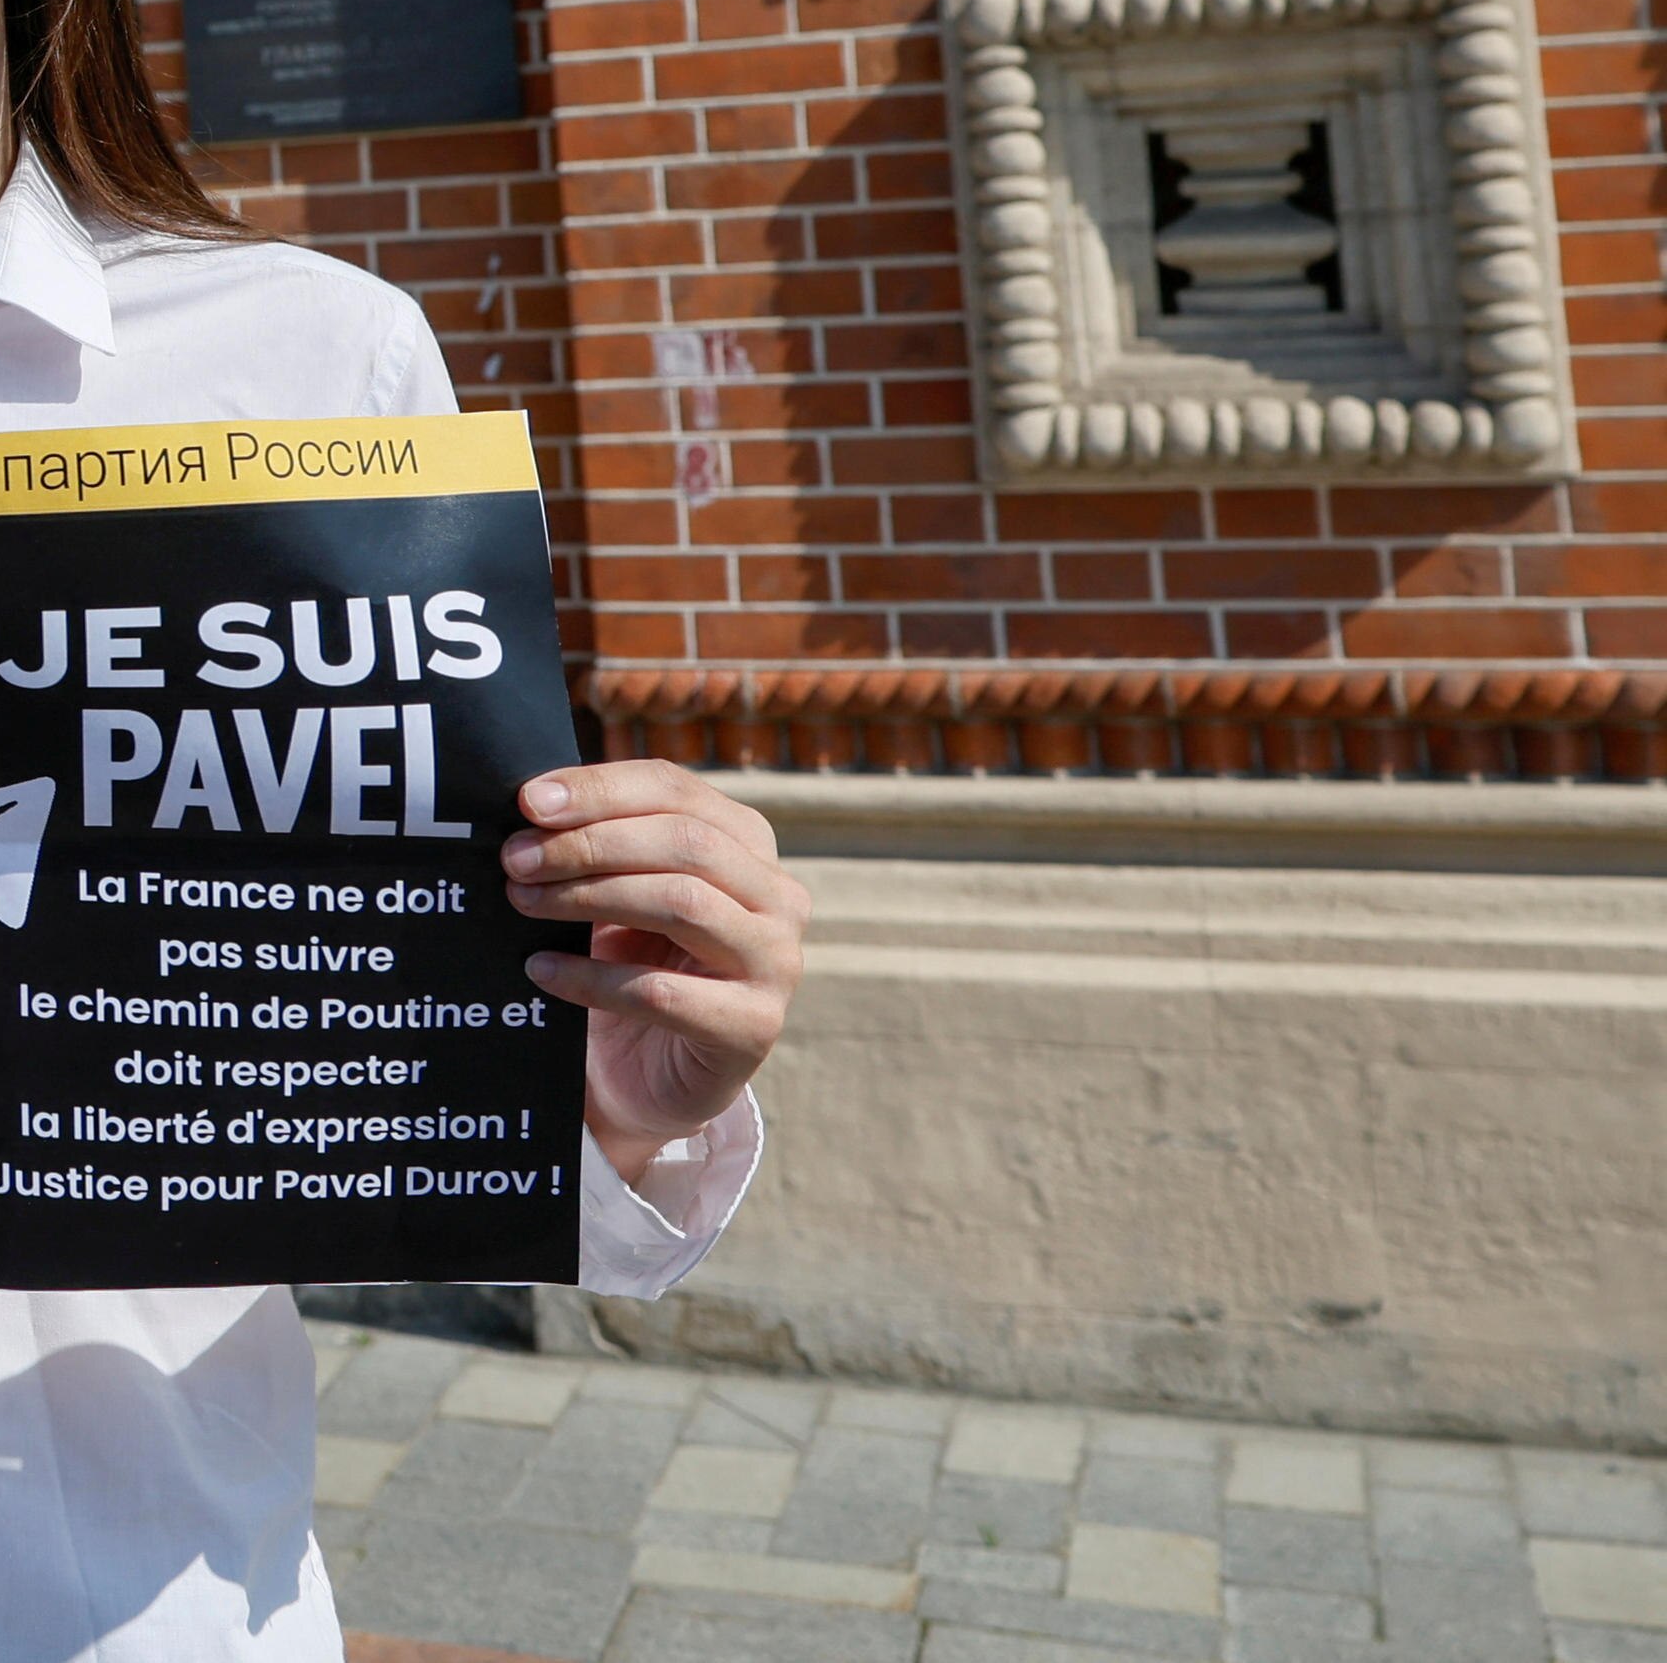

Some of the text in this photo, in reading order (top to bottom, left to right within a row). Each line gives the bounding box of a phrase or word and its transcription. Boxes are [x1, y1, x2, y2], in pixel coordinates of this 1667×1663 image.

[3, 444, 206, 501] партия
[227, 431, 419, 480] России
[196, 590, 503, 688] SUIS
[81, 703, 472, 839] PAVEL
[78, 869, 465, 914] La France ne doit
[159, 936, 395, 976] pas suivre
[19, 984, 545, 1030] le chemin de Poutine et
[114, 1051, 427, 1095] doit respecter
[20, 1104, 60, 1139] la
[73, 1106, 216, 1144] liberté
[227, 1107, 505, 1152] d'expression
[160, 1174, 263, 1210] pour
[275, 1166, 393, 1199] Pavel
[405, 1166, 538, 1197] Durov
